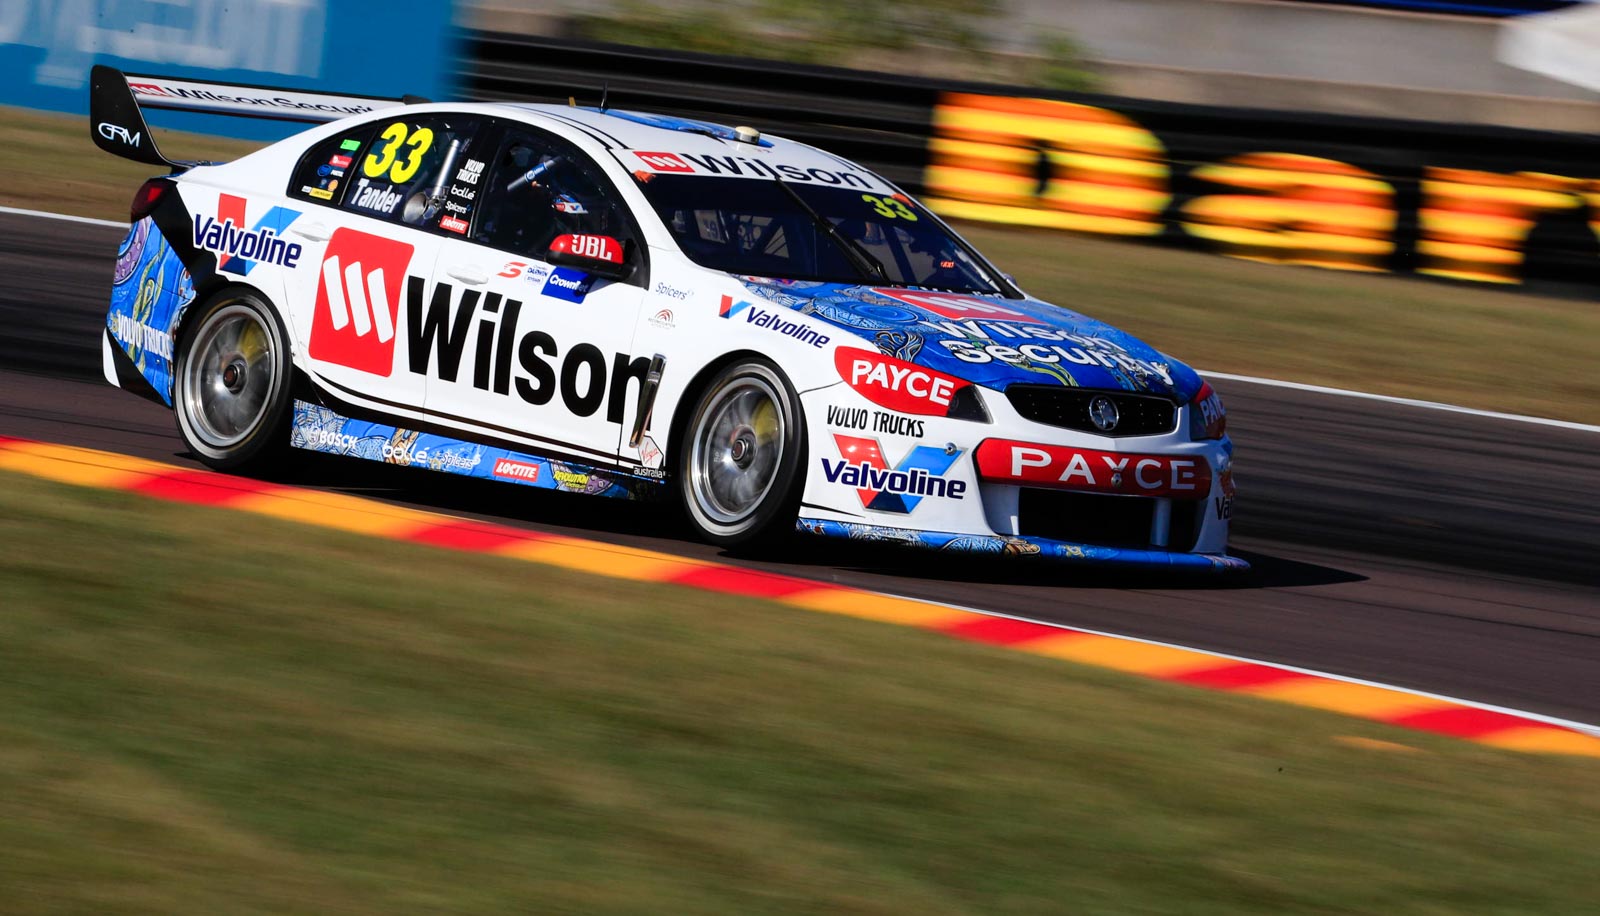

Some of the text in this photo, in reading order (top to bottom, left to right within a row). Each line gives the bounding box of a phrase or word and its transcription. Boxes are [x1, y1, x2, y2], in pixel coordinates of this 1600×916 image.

[98, 122, 140, 148] GRM
[363, 122, 433, 184] 33
[681, 153, 874, 189] Wilson
[922, 92, 1600, 285] Dar
[351, 177, 403, 214] Tander
[861, 194, 918, 221] 33
[193, 213, 303, 269] Valvoline
[655, 281, 688, 300] Spicers
[746, 306, 831, 349] Valvoline
[920, 319, 1128, 353] Wilson
[407, 276, 652, 429] Wilson
[851, 359, 955, 407] PAYCE
[319, 430, 358, 449] BOSCH
[827, 404, 925, 438] VOLVO TRUCKS
[495, 461, 537, 479] LOCTITE
[821, 457, 967, 500] Valvoline
[1010, 446, 1197, 491] PAYCE
